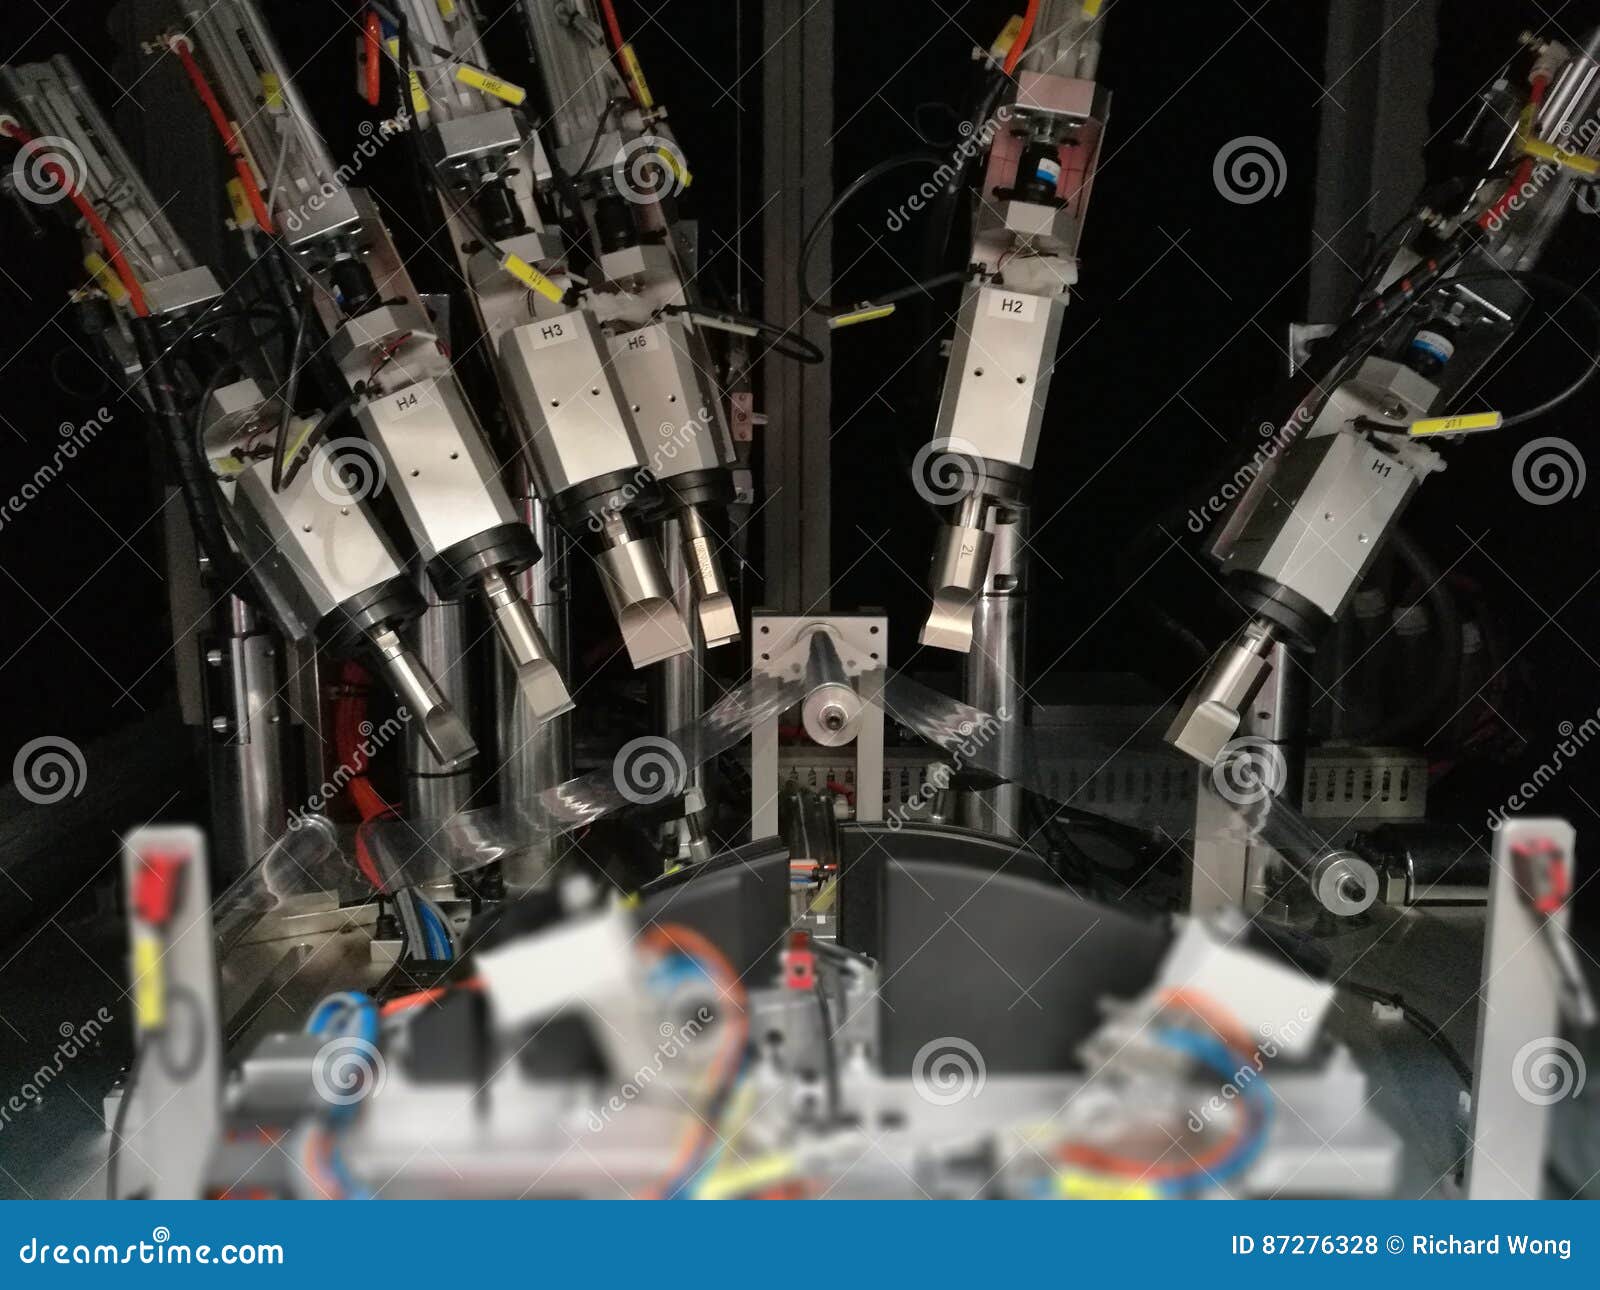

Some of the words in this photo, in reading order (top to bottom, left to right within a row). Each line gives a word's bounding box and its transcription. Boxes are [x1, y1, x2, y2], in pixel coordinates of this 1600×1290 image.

[1001, 298, 1023, 313] H2
[541, 324, 563, 340] H3
[628, 335, 647, 350] H6
[396, 393, 418, 411] H4
[1372, 459, 1392, 477] H1
[960, 544, 975, 559] 2L
